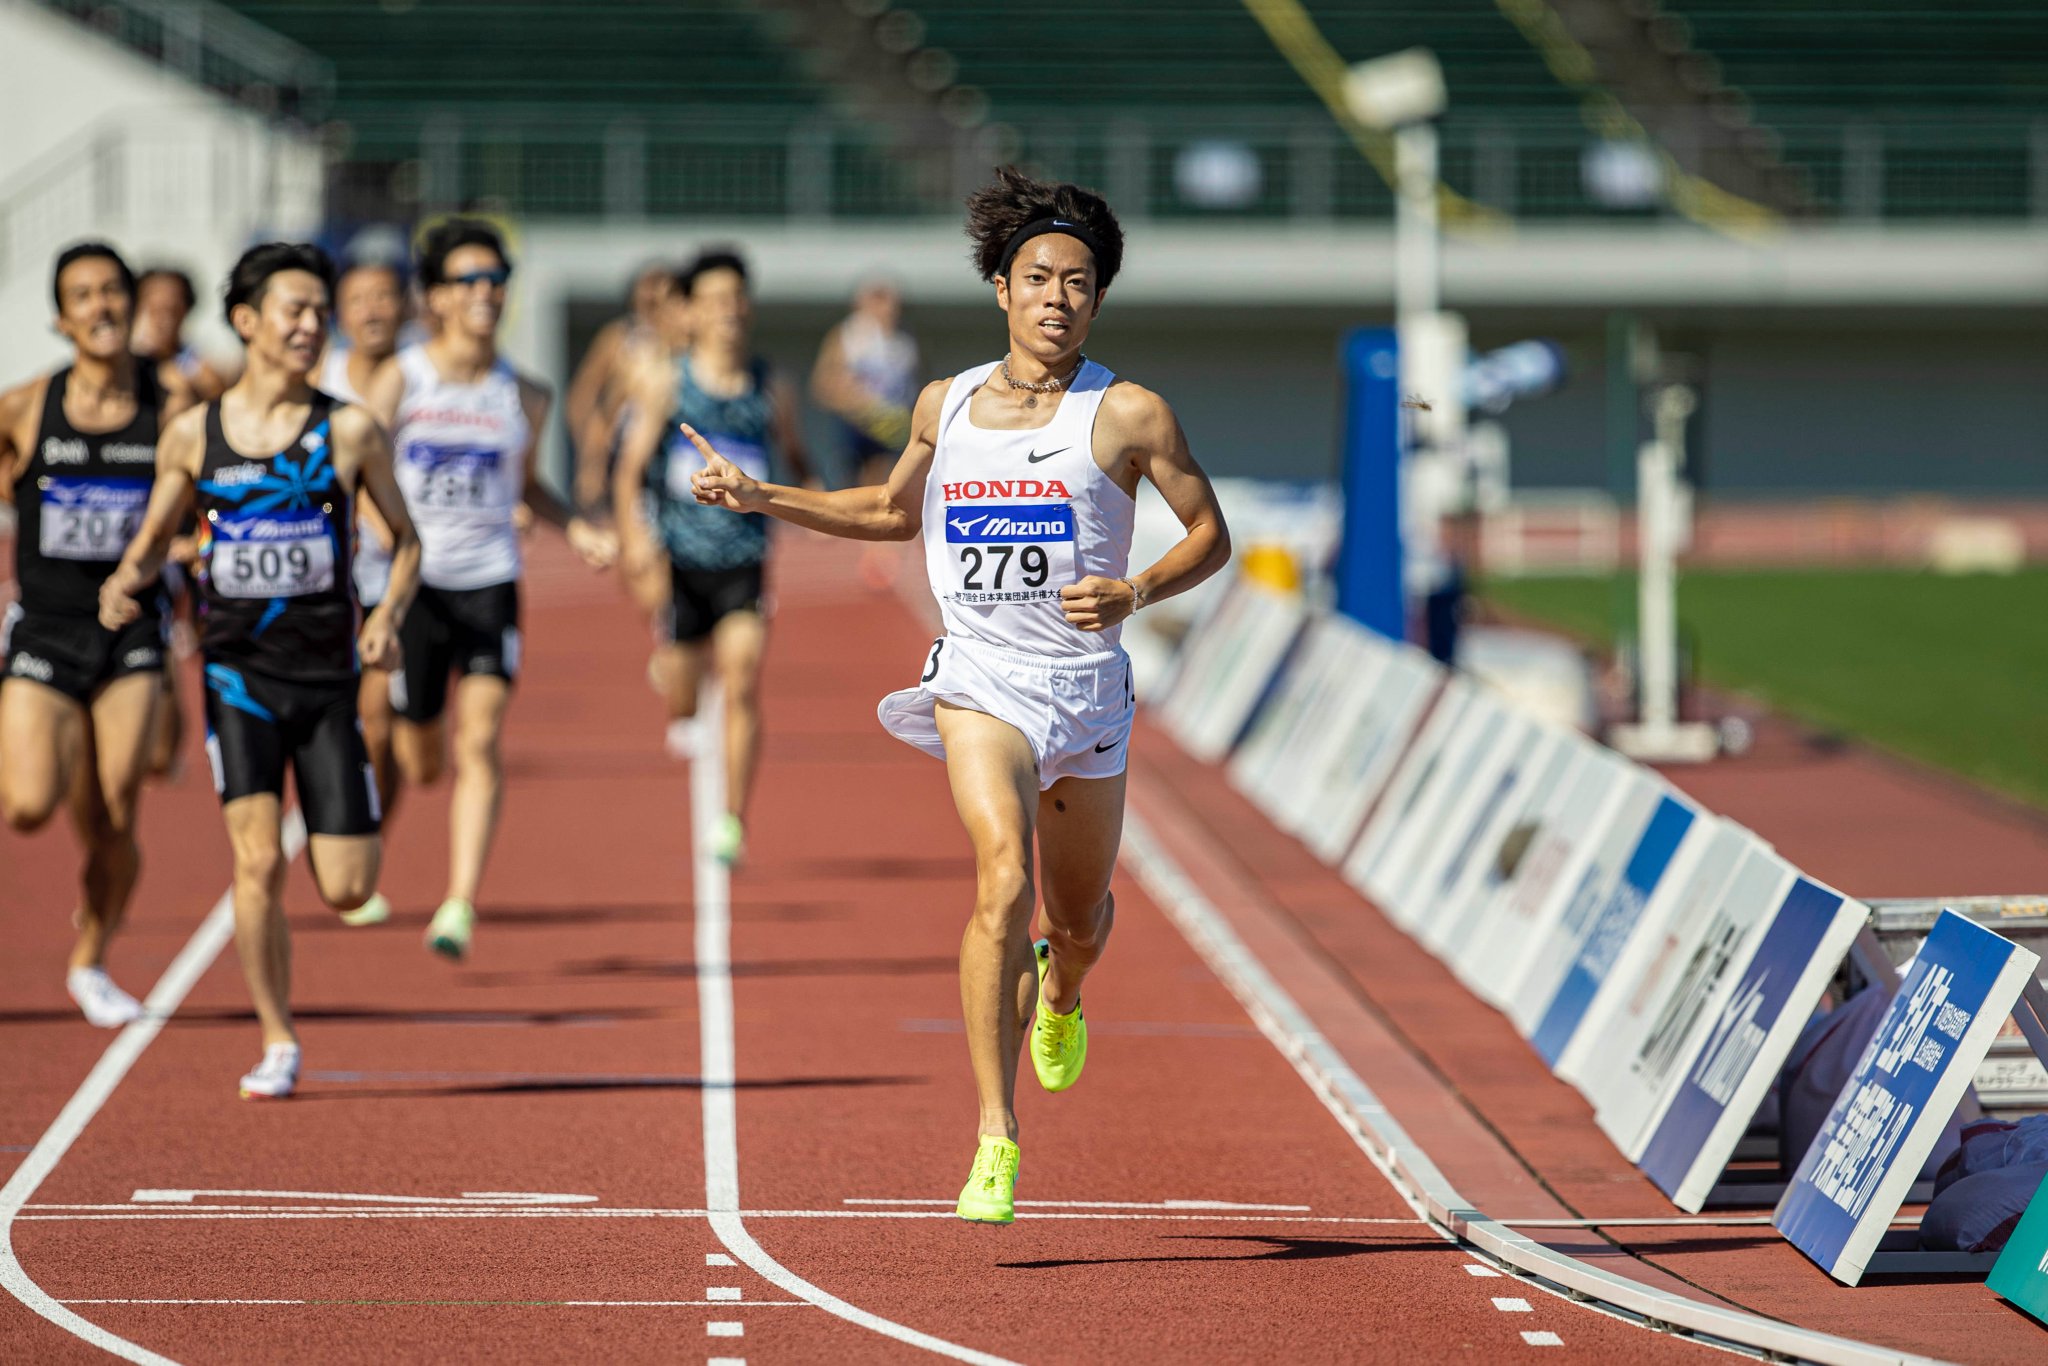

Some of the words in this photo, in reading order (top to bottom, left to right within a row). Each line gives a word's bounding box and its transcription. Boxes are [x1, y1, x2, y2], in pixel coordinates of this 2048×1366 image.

[942, 480, 1072, 501] HONDA
[233, 544, 309, 581] 509
[960, 545, 1049, 591] 279
[1875, 963, 1954, 1078] 全日本
